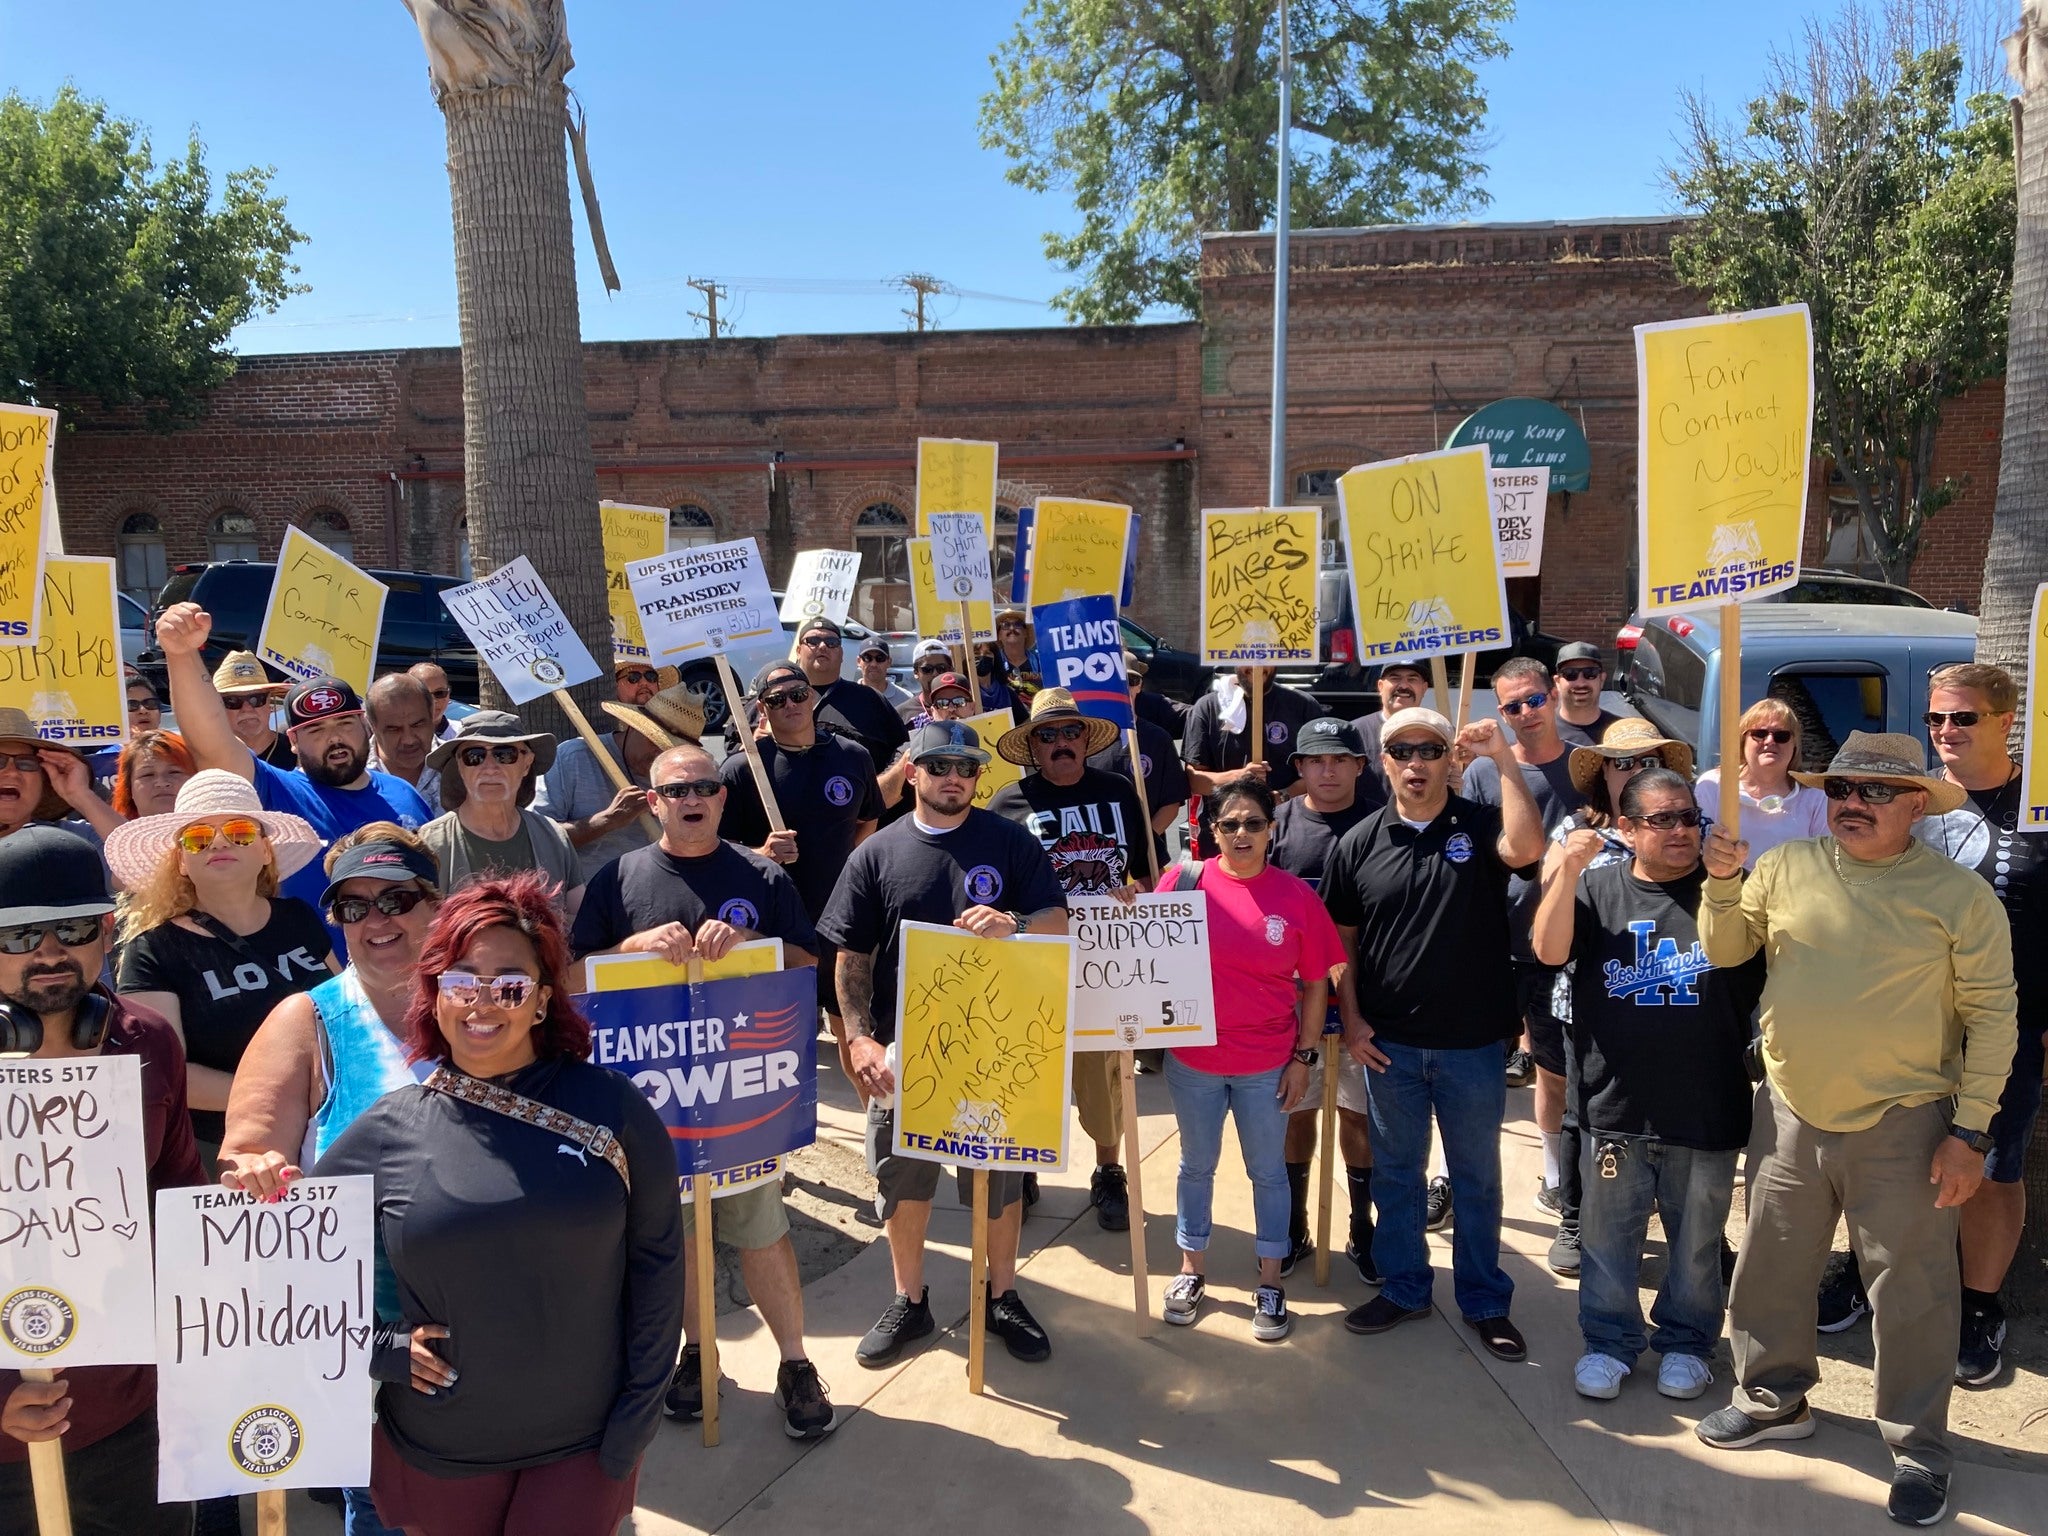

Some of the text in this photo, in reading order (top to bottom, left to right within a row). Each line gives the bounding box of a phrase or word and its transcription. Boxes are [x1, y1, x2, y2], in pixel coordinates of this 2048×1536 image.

[1472, 424, 1566, 442] Hong Kong
[1659, 395, 1782, 446] Contract
[1521, 448, 1567, 463] Lums
[1391, 470, 1441, 523] ON
[933, 519, 982, 535] NO CBA
[944, 535, 978, 558] SHUT
[638, 546, 749, 577] UPS TEAMSTERS
[661, 557, 749, 587] SUPPORT
[1697, 557, 1768, 578] WE ARE THE
[43, 571, 75, 617] N
[455, 567, 515, 597] TEAMSTERS 517
[1652, 560, 1795, 604] TEAMSTERS
[640, 581, 742, 616] TRANSDEV
[666, 597, 747, 623] TEAMSTERS
[726, 609, 761, 633] 517
[1400, 624, 1463, 639] WE ARE THE
[1208, 649, 1312, 660] TEAMSTERS
[1366, 627, 1502, 657] TEAMSTERS
[293, 656, 323, 675] WE ARE
[1026, 802, 1127, 851] CALI
[1090, 903, 1193, 921] TEAMSTERS
[1078, 919, 1204, 950] SUPPORT
[202, 946, 327, 1001] LOVE
[1075, 958, 1169, 989] OCAL
[1603, 959, 1637, 988] Los
[1119, 1014, 1139, 1022] UPS
[1161, 999, 1198, 1026] 517
[62, 1066, 99, 1083] 517
[903, 1131, 1058, 1164] TEAMSTERS
[943, 1130, 1016, 1145] WE ARE THE
[193, 1186, 338, 1210] TEAMSRS 517
[37, 1290, 62, 1306] LOCAL
[54, 1335, 68, 1346] CA
[233, 1409, 299, 1444] TEAMSTERS LOCAL 517
[280, 1456, 292, 1467] CA
